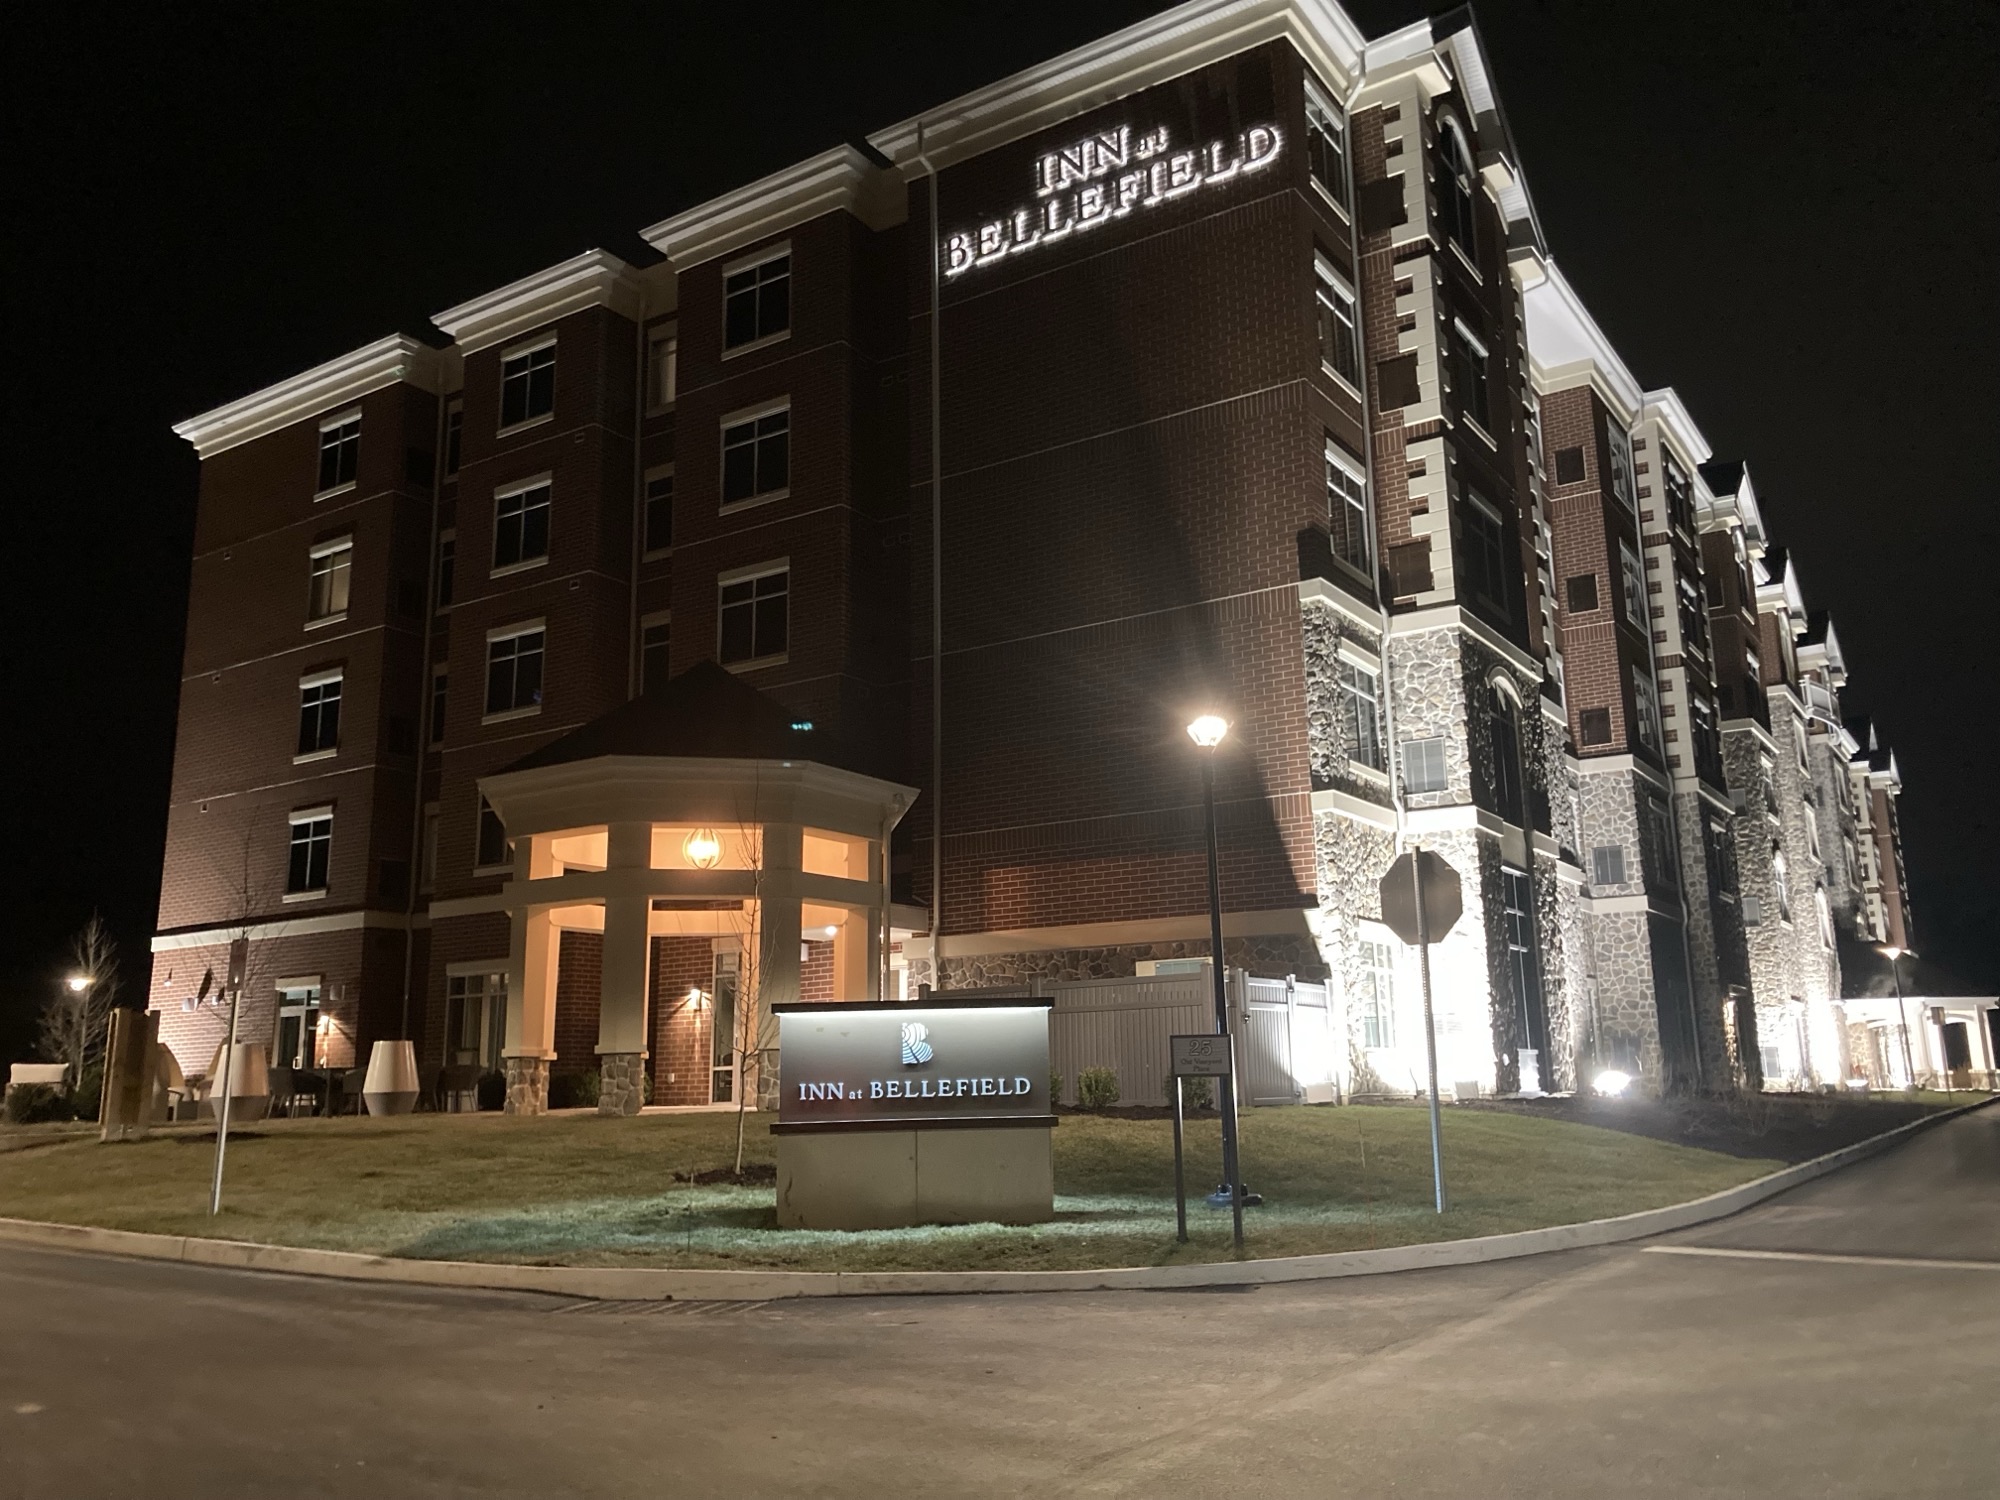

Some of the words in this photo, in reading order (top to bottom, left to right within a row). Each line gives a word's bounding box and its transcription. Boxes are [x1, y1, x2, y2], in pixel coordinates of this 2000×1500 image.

[1036, 125, 1129, 196] INN
[944, 125, 1284, 277] BELLEFIELD
[1189, 1040, 1213, 1056] 25
[799, 1082, 844, 1101] INN
[849, 1087, 863, 1100] at
[870, 1077, 1031, 1099] BELLEFIELD
